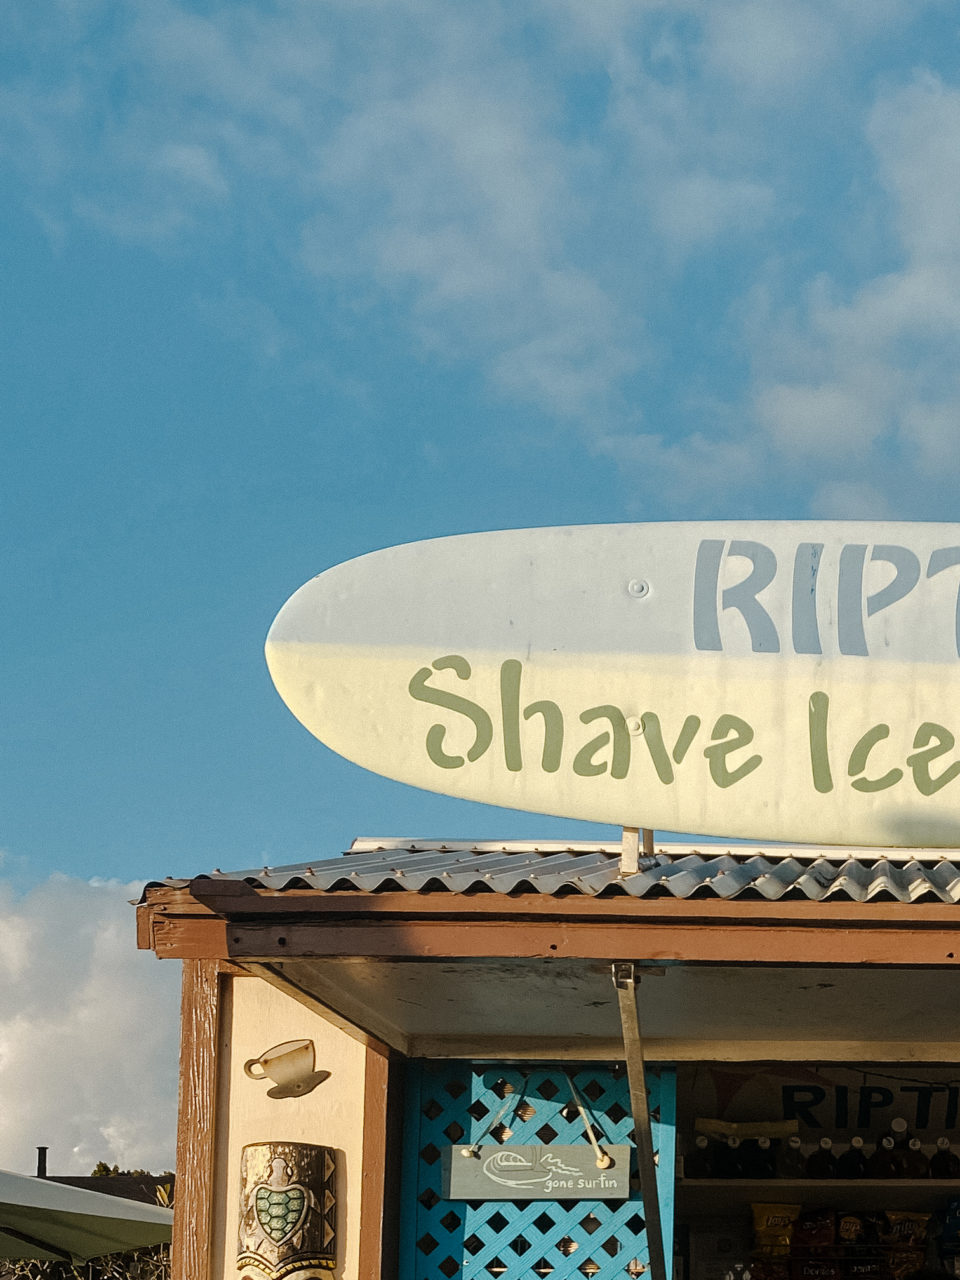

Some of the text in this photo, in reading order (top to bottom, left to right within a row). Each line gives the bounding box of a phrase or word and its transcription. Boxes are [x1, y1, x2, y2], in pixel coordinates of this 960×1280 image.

[408, 655, 762, 787] Shave
[544, 1173, 617, 1192] gone surfin
